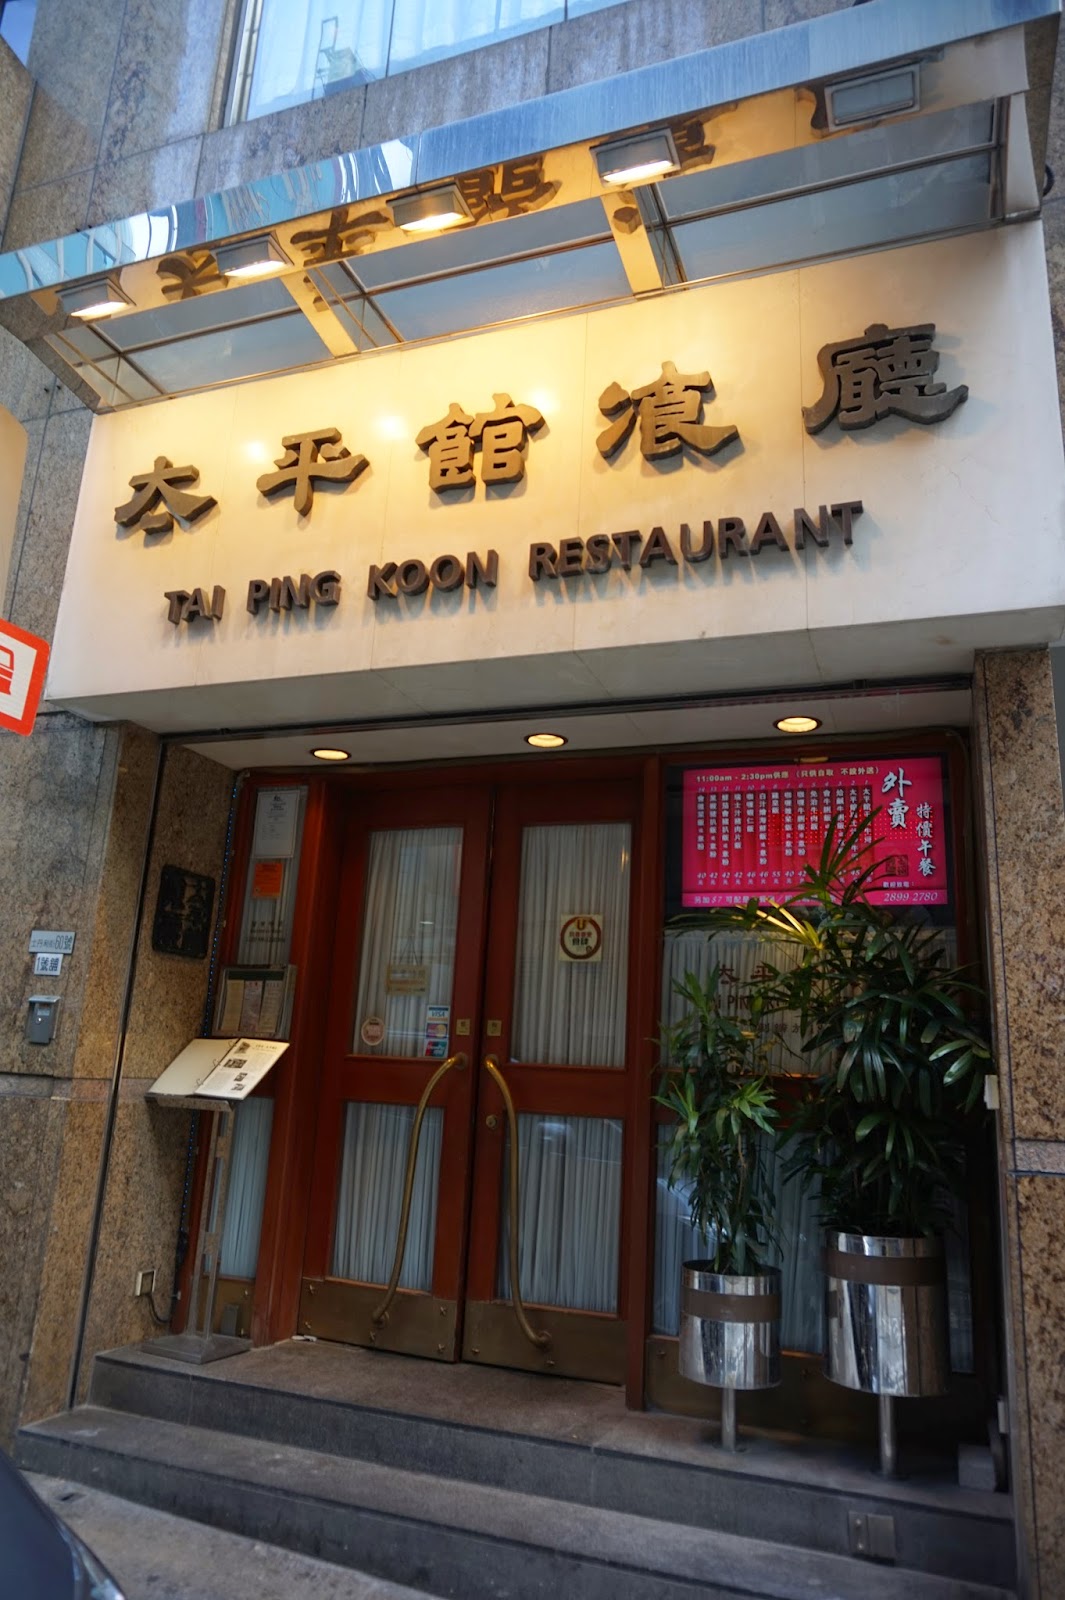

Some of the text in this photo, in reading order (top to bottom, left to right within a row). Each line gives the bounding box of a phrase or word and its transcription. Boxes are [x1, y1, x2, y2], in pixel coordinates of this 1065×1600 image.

[164, 500, 864, 625] TAI PING KOON RESTAURANT
[881, 767, 913, 829] 外賣
[916, 801, 937, 877] 特價午餐
[883, 891, 938, 902] 2899 2780
